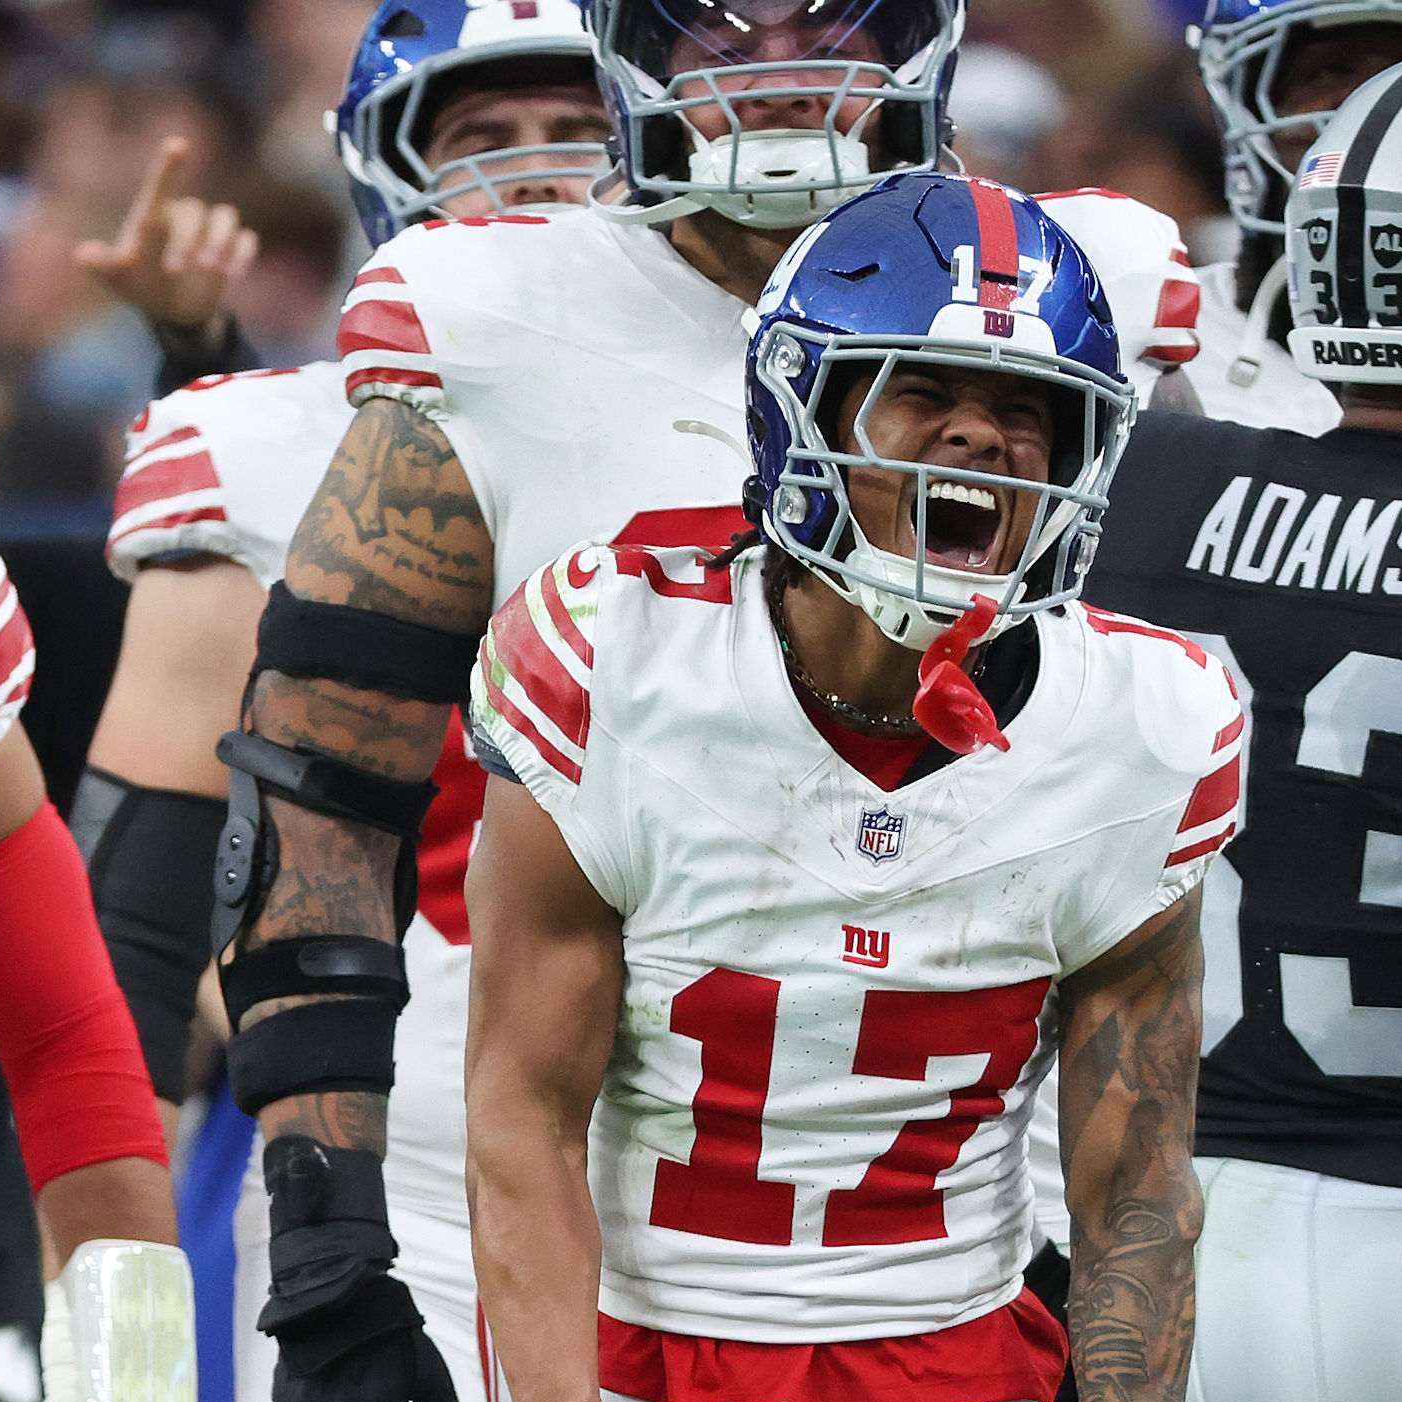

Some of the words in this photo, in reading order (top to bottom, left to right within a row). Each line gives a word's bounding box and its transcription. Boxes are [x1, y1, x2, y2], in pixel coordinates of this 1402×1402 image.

[951, 244, 1055, 316] 17
[862, 829, 896, 856] NFL
[649, 967, 1054, 1247] 17
